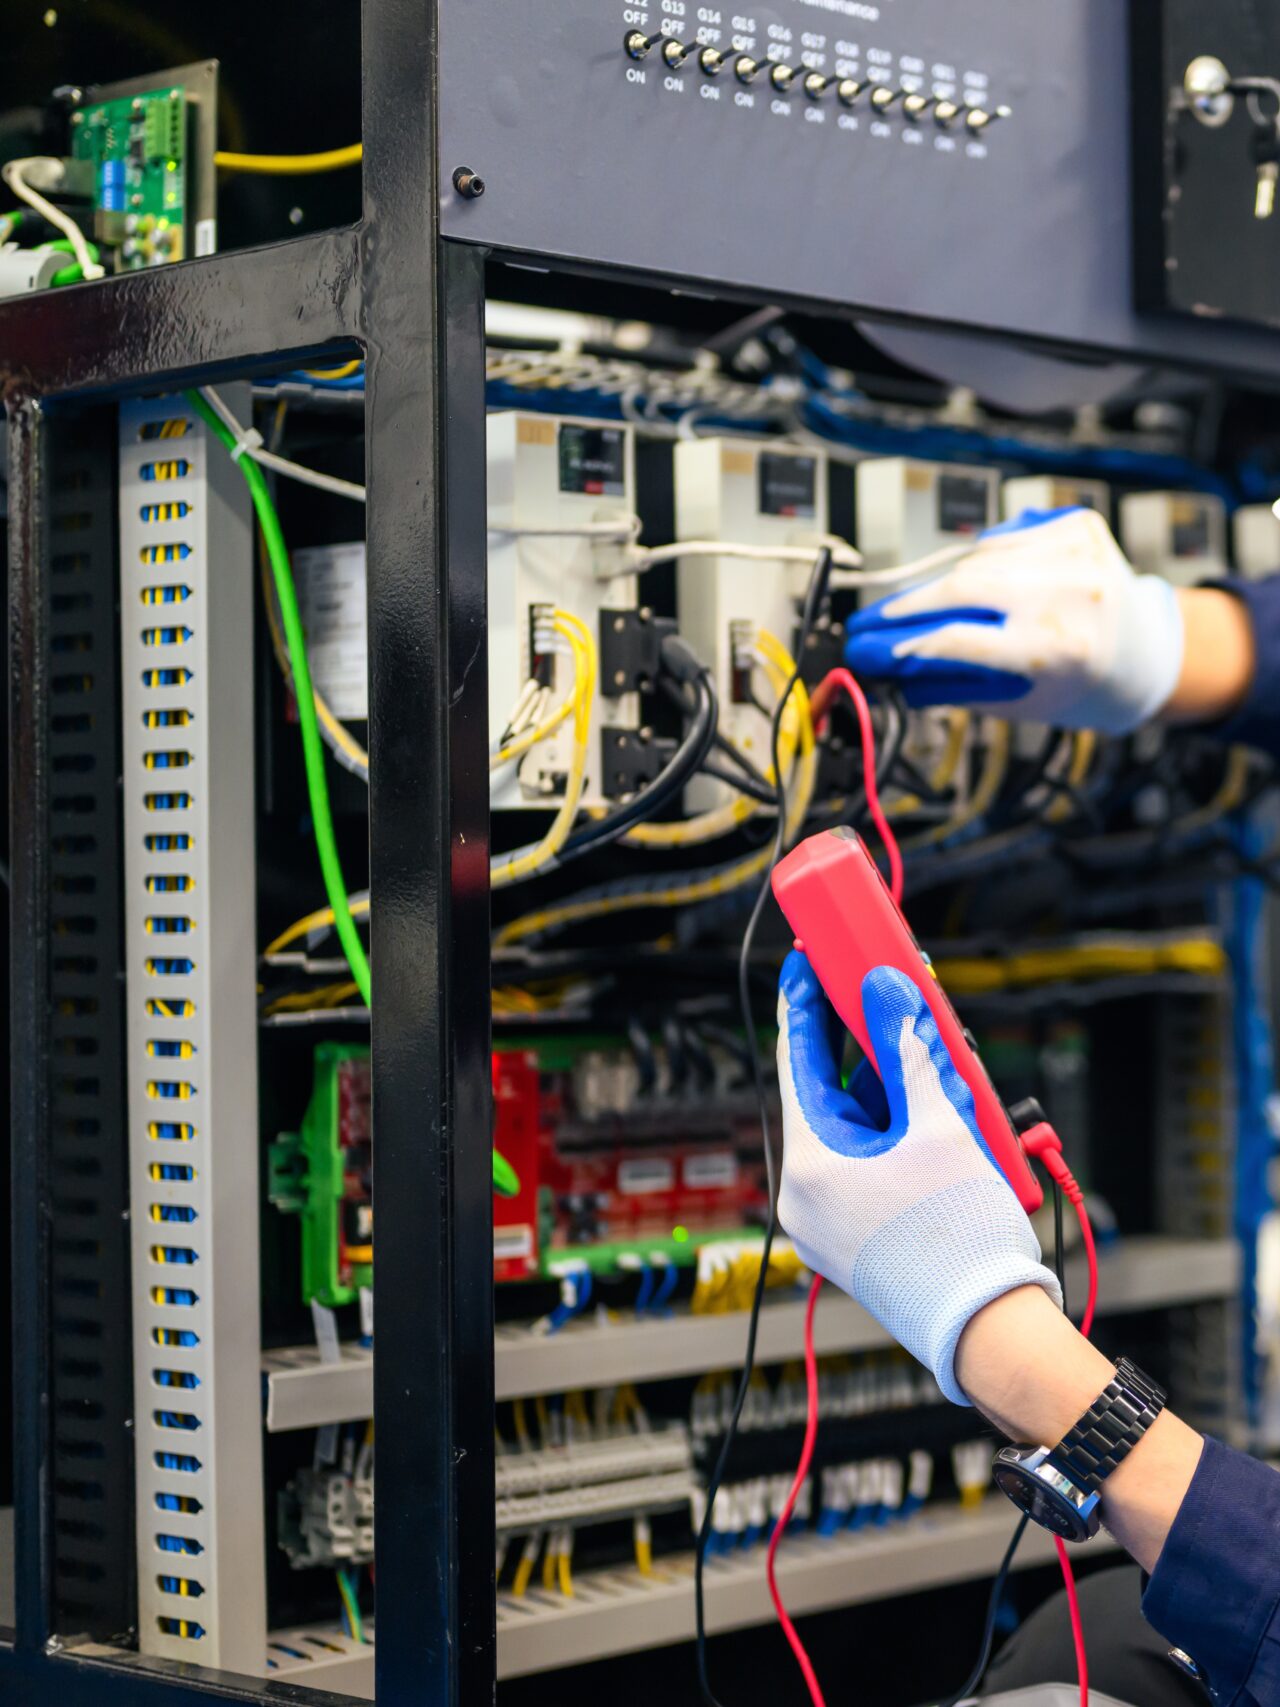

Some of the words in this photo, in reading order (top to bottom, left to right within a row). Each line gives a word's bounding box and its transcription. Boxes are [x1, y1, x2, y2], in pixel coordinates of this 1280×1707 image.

[623, 9, 648, 26] OFF
[661, 18, 685, 35] OFF
[697, 26, 721, 43] OFF
[731, 34, 756, 51] OFF
[767, 42, 792, 60] OFF
[661, 0, 685, 16] G13
[697, 7, 721, 24] G14
[731, 15, 756, 33] G15
[767, 24, 792, 42] G16
[626, 68, 646, 84] ON
[664, 76, 684, 92] ON
[700, 84, 720, 100] ON
[734, 91, 754, 108] ON
[771, 99, 791, 116] ON
[804, 107, 825, 124] ON
